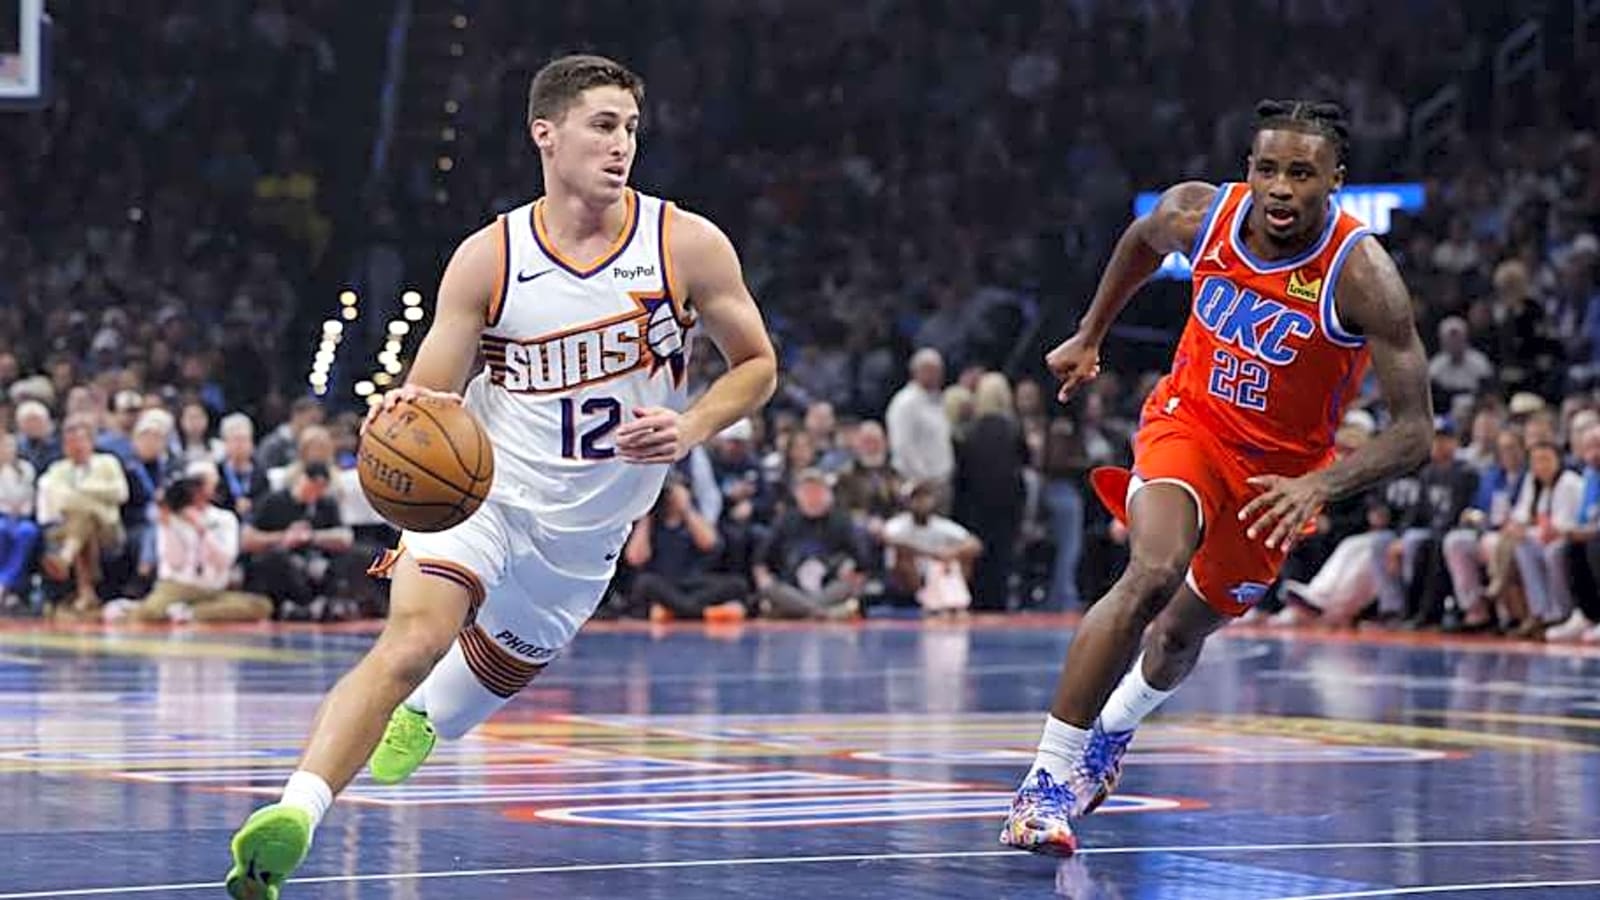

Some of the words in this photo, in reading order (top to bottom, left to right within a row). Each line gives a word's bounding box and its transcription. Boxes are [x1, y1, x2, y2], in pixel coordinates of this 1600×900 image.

[613, 265, 655, 280] PayPal
[1194, 275, 1314, 365] OKC
[504, 320, 640, 391] SUNS
[1208, 350, 1269, 411] 22
[559, 397, 621, 460] 12
